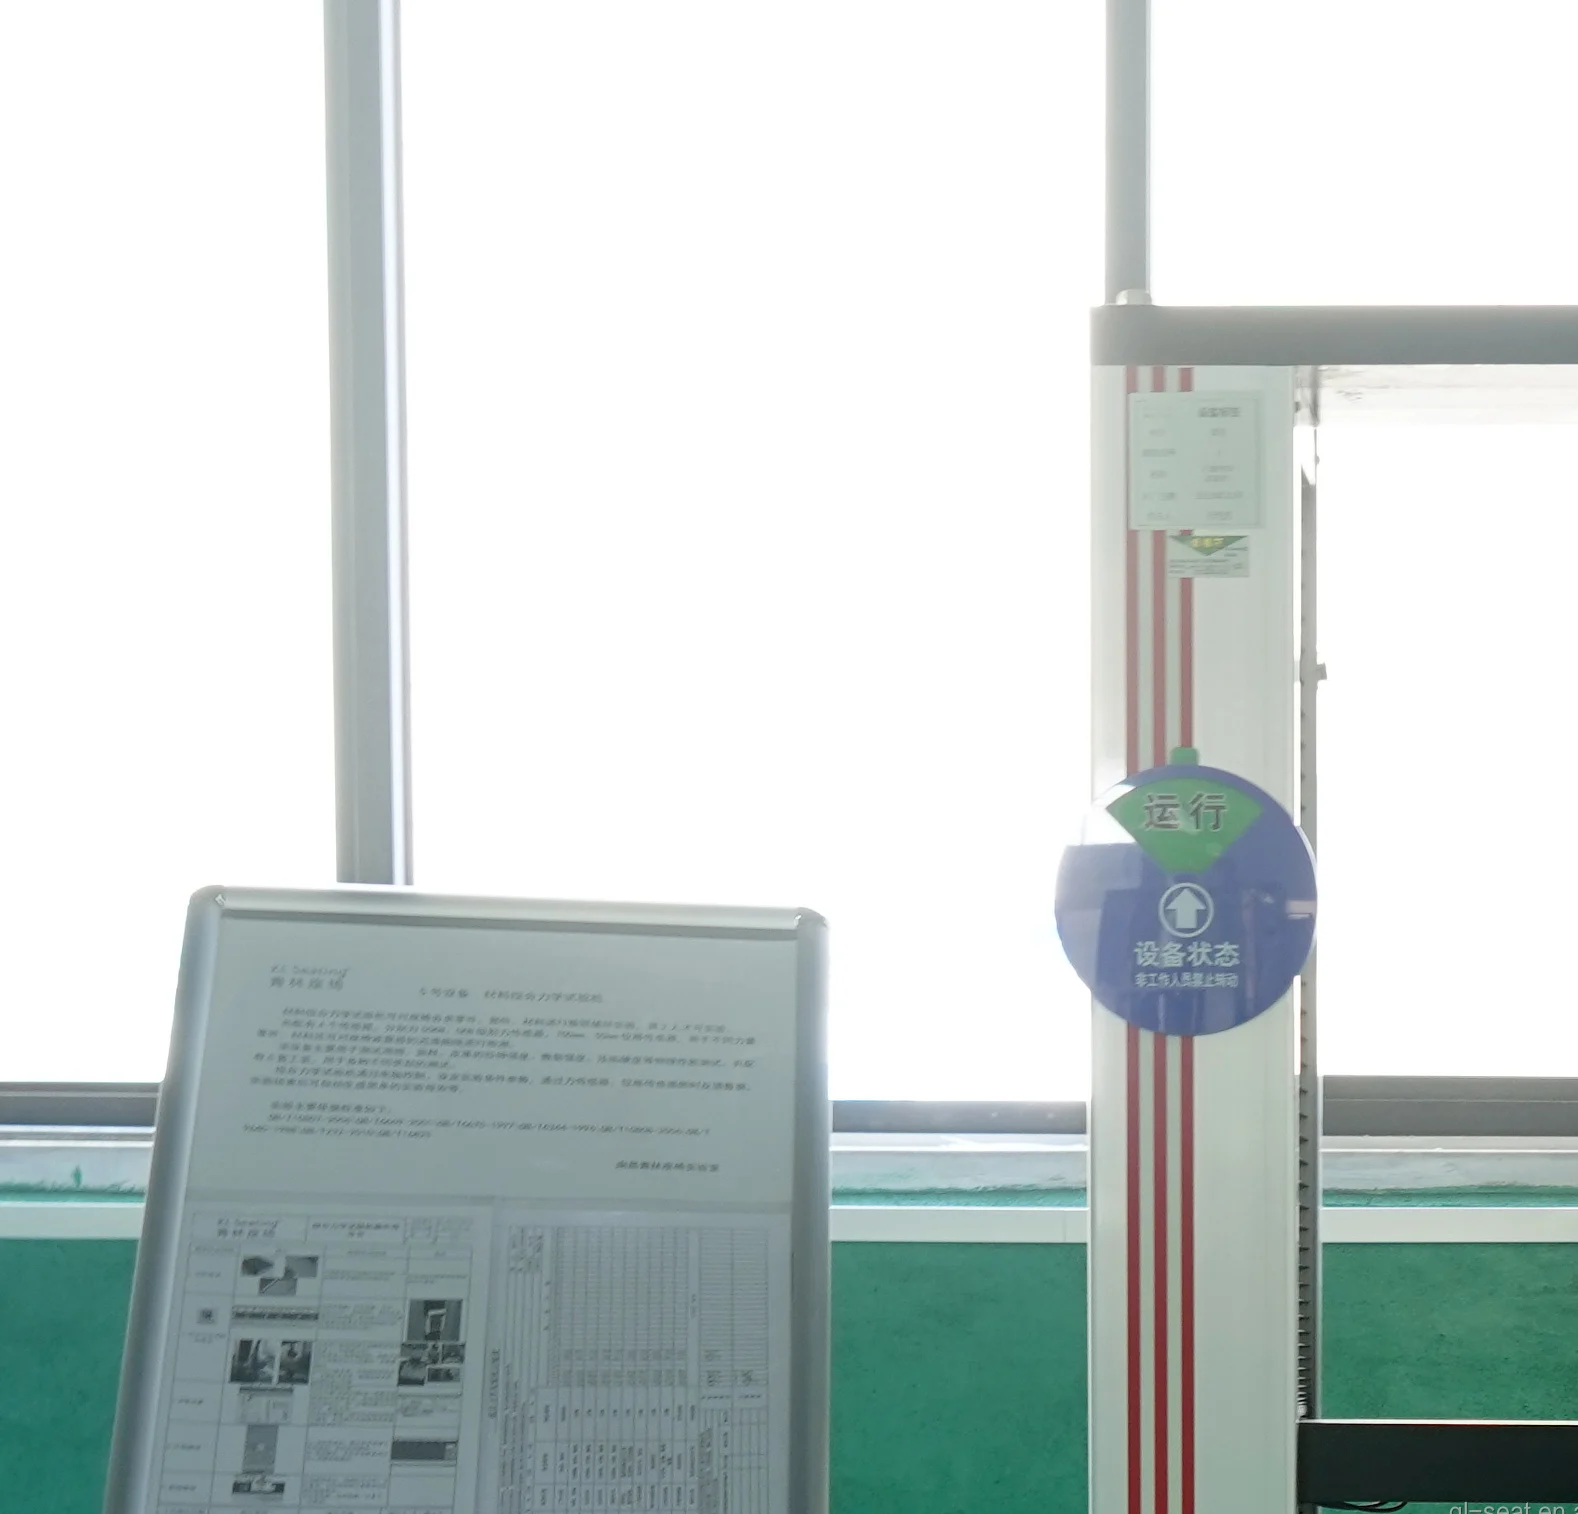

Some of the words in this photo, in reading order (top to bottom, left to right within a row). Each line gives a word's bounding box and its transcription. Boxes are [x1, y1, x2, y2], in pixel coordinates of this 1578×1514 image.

[1143, 792, 1229, 831] 运行
[1133, 940, 1242, 969] 设备状态
